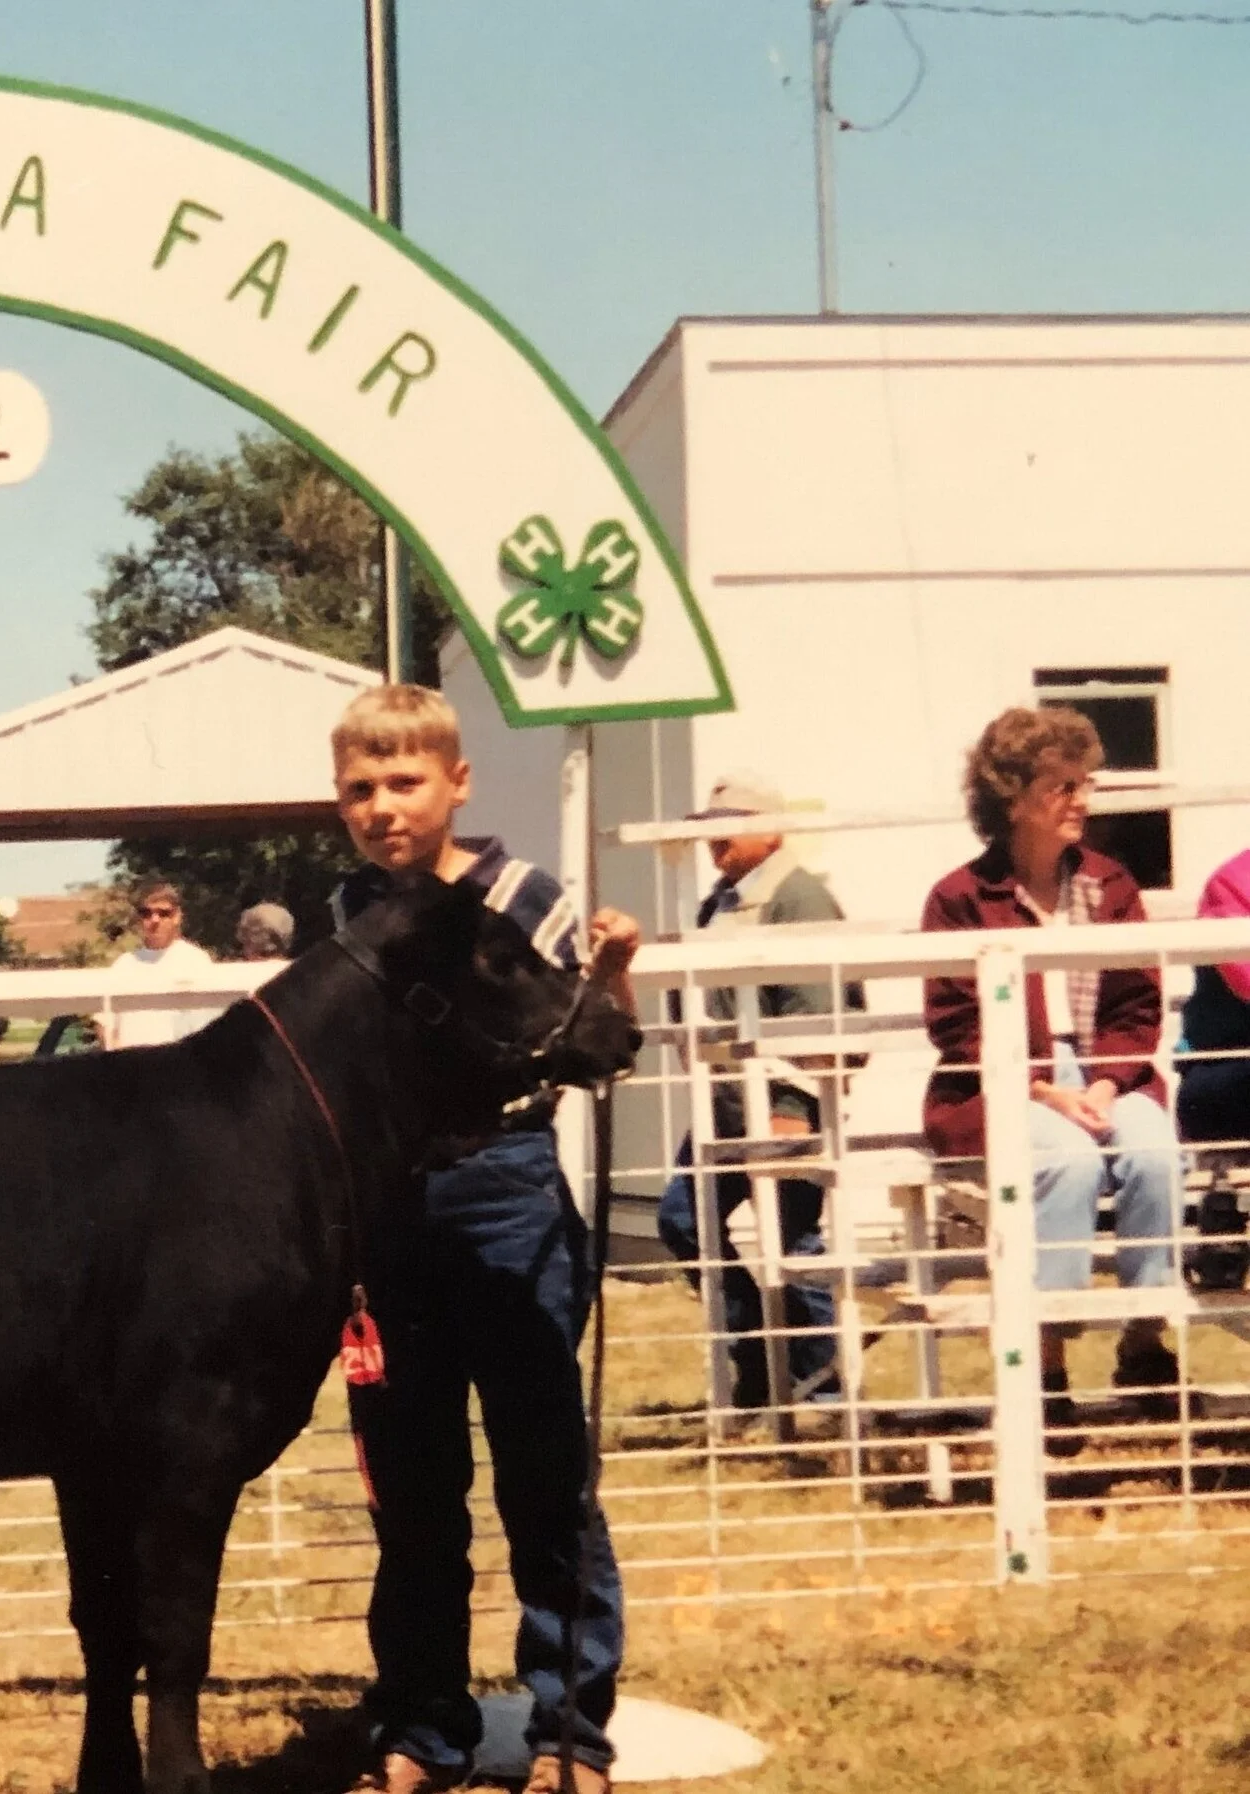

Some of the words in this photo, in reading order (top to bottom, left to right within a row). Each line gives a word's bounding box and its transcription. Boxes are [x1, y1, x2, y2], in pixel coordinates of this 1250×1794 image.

[151, 199, 438, 418] FAIR
[508, 523, 556, 572] H
[587, 533, 635, 583] H
[505, 598, 555, 648] H
[589, 598, 639, 646] H
